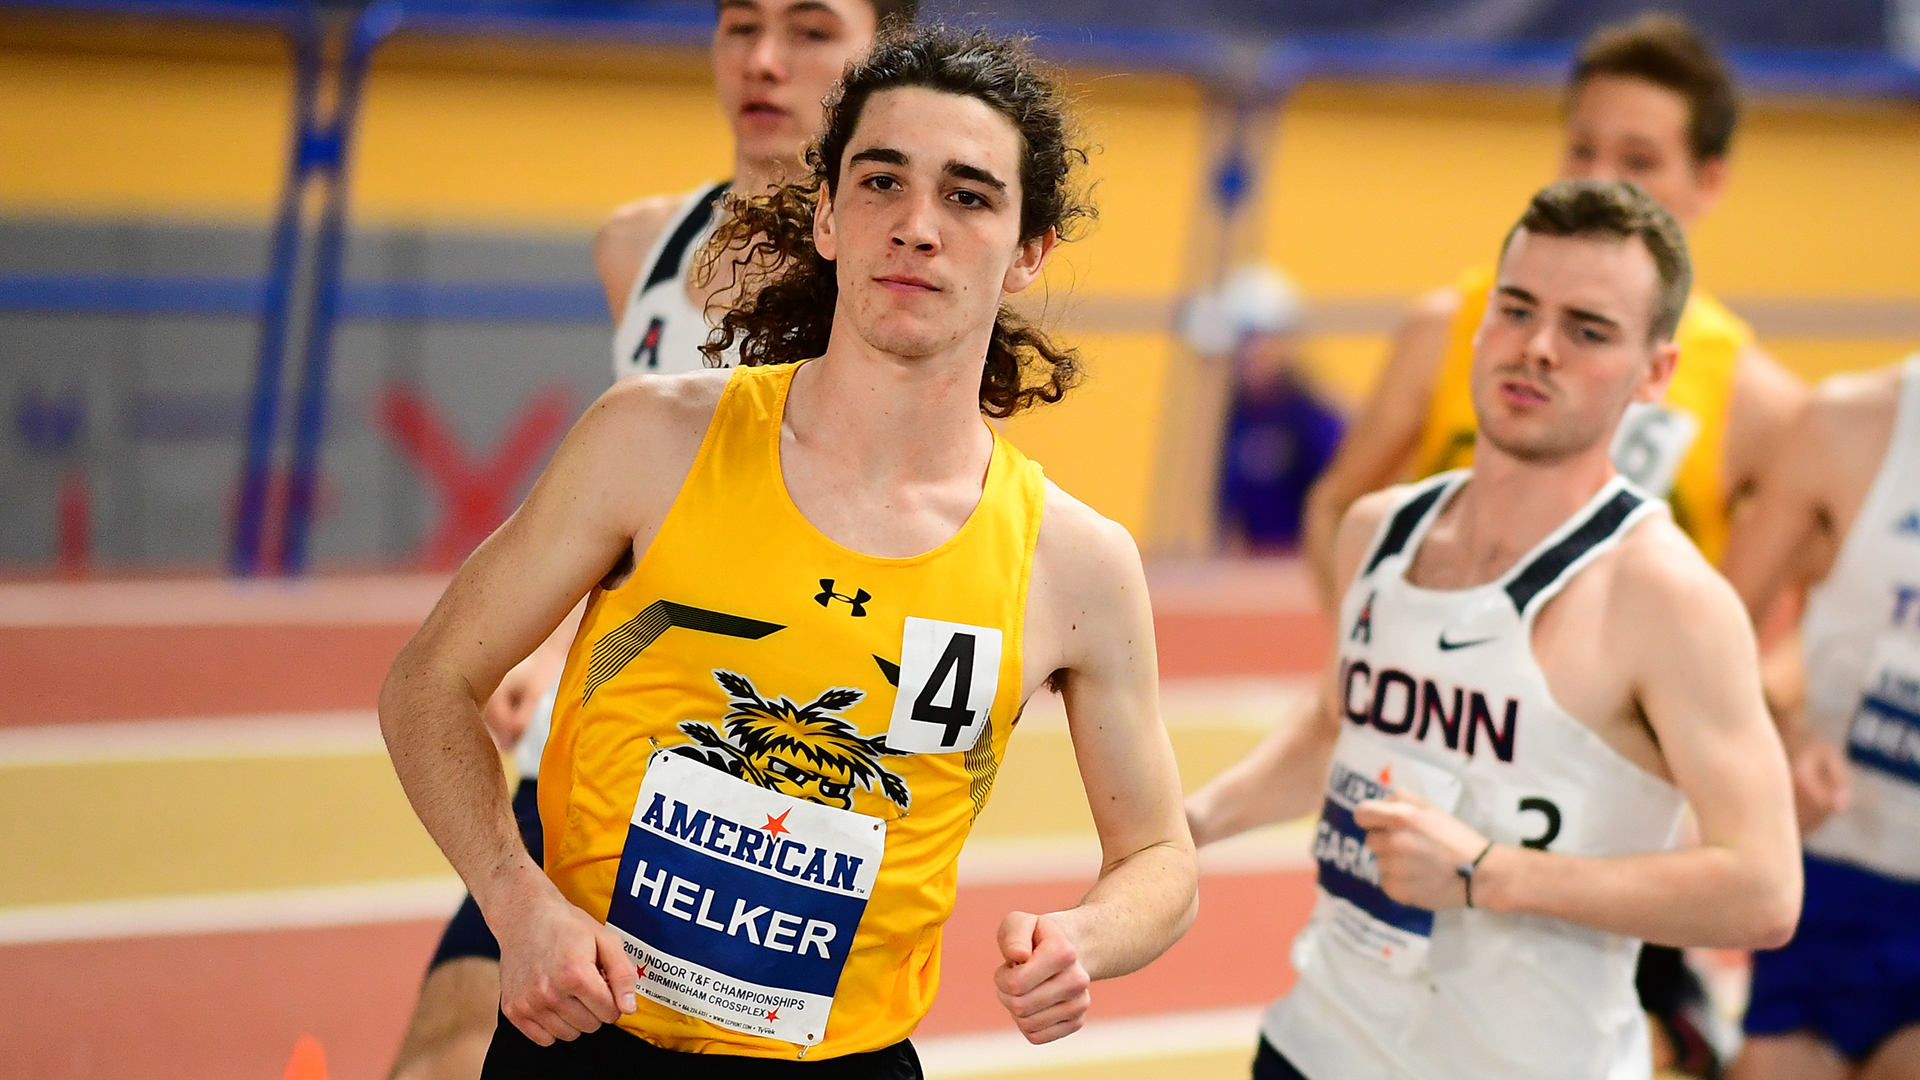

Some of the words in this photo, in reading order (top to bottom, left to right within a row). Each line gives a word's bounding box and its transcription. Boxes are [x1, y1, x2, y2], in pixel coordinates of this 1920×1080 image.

[910, 631, 976, 748] 4
[641, 791, 864, 892] AMERICAN
[630, 859, 838, 960] HELKER
[623, 940, 644, 961] 2019
[644, 952, 687, 979] INDOOR
[690, 971, 712, 988] T&F
[712, 980, 806, 1011] CHAMPIONSHIPS
[647, 971, 708, 1002] BIRMINGHAM
[708, 990, 767, 1018] CROSSPLEX
